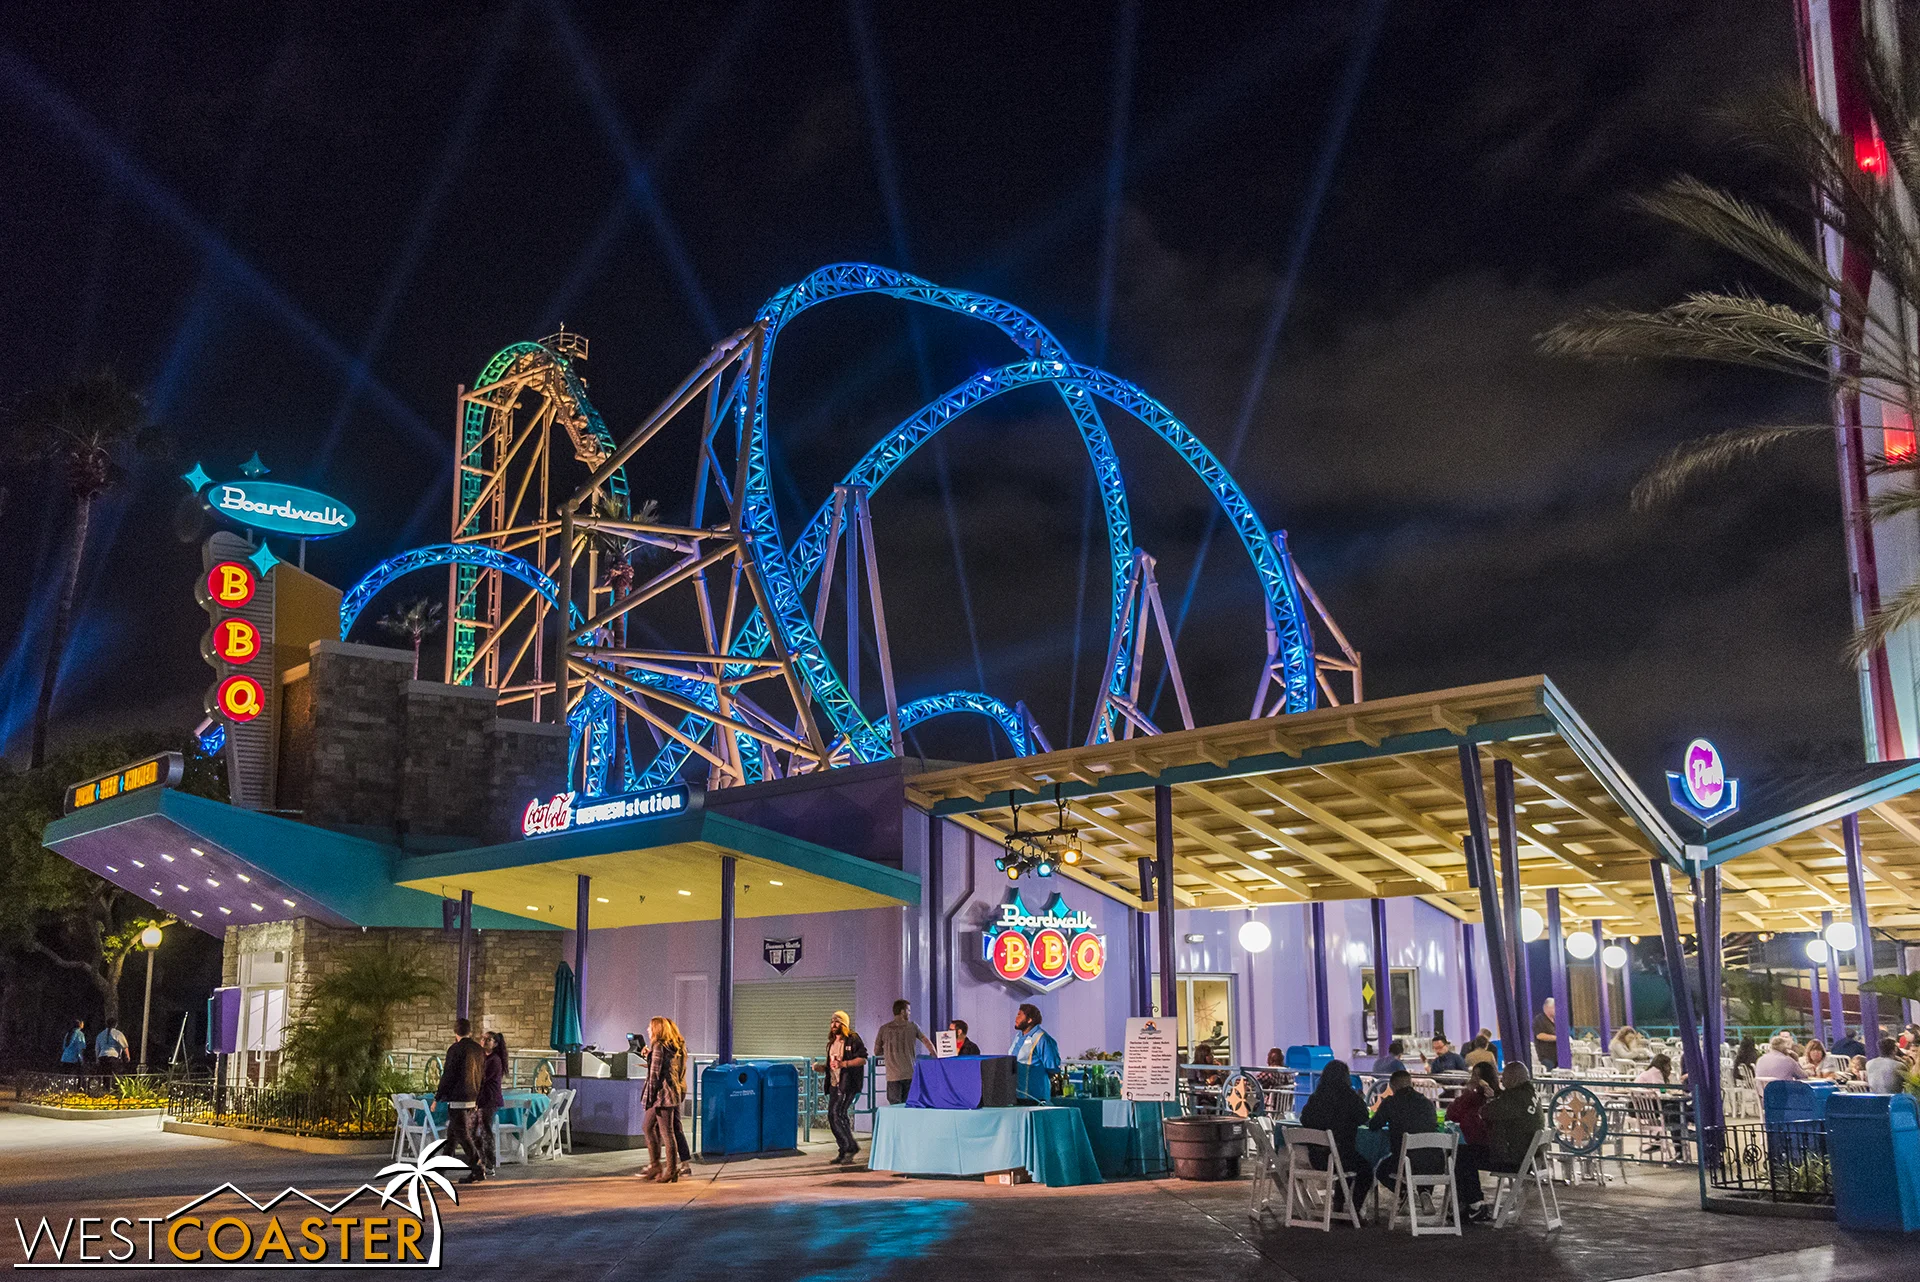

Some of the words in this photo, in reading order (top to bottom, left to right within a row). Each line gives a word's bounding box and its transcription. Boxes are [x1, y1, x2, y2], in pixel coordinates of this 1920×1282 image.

[219, 485, 348, 528] Boardwalk
[626, 792, 681, 818] station
[996, 904, 1098, 929] Boardwalk
[1003, 935, 1101, 977] BBQ
